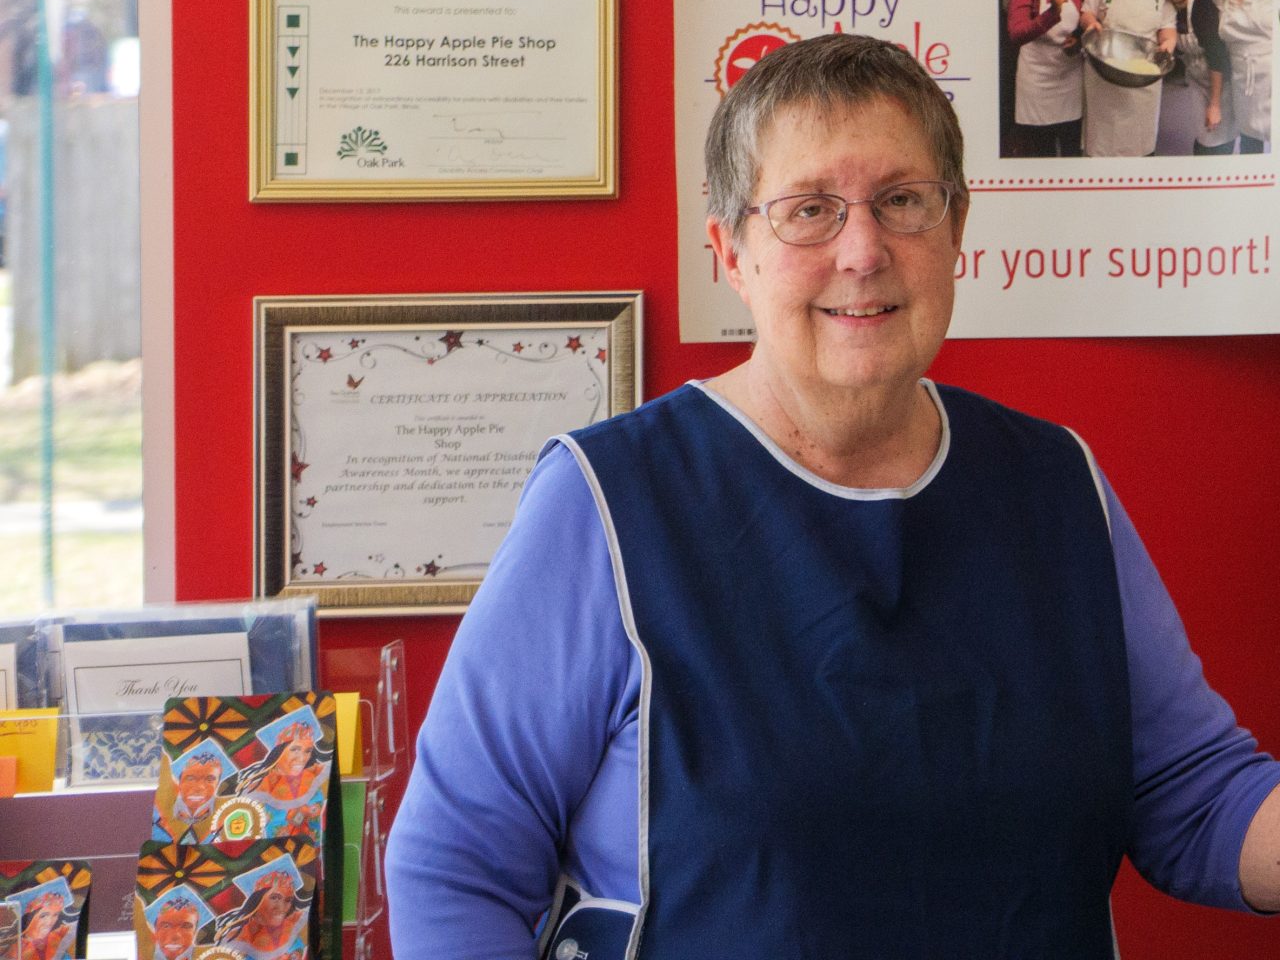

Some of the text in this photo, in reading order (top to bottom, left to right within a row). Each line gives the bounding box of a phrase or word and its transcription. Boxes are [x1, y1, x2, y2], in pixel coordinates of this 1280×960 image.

[353, 35, 557, 52] The Happy Apple Pie Shop
[384, 54, 525, 68] 226 Harrison Street
[357, 157, 405, 169] Oak Park
[953, 235, 1271, 291] or your support!
[395, 423, 505, 437] The Happy Apple Pie
[434, 439, 462, 451] Shop
[361, 454, 424, 466] recognition
[426, 452, 438, 465] of
[440, 451, 492, 463] National
[339, 468, 400, 479] Awareness
[402, 467, 441, 478] Month,
[463, 466, 521, 478] appreciate
[322, 480, 509, 495] partnership and dedication to the
[116, 677, 199, 697] Thank You
